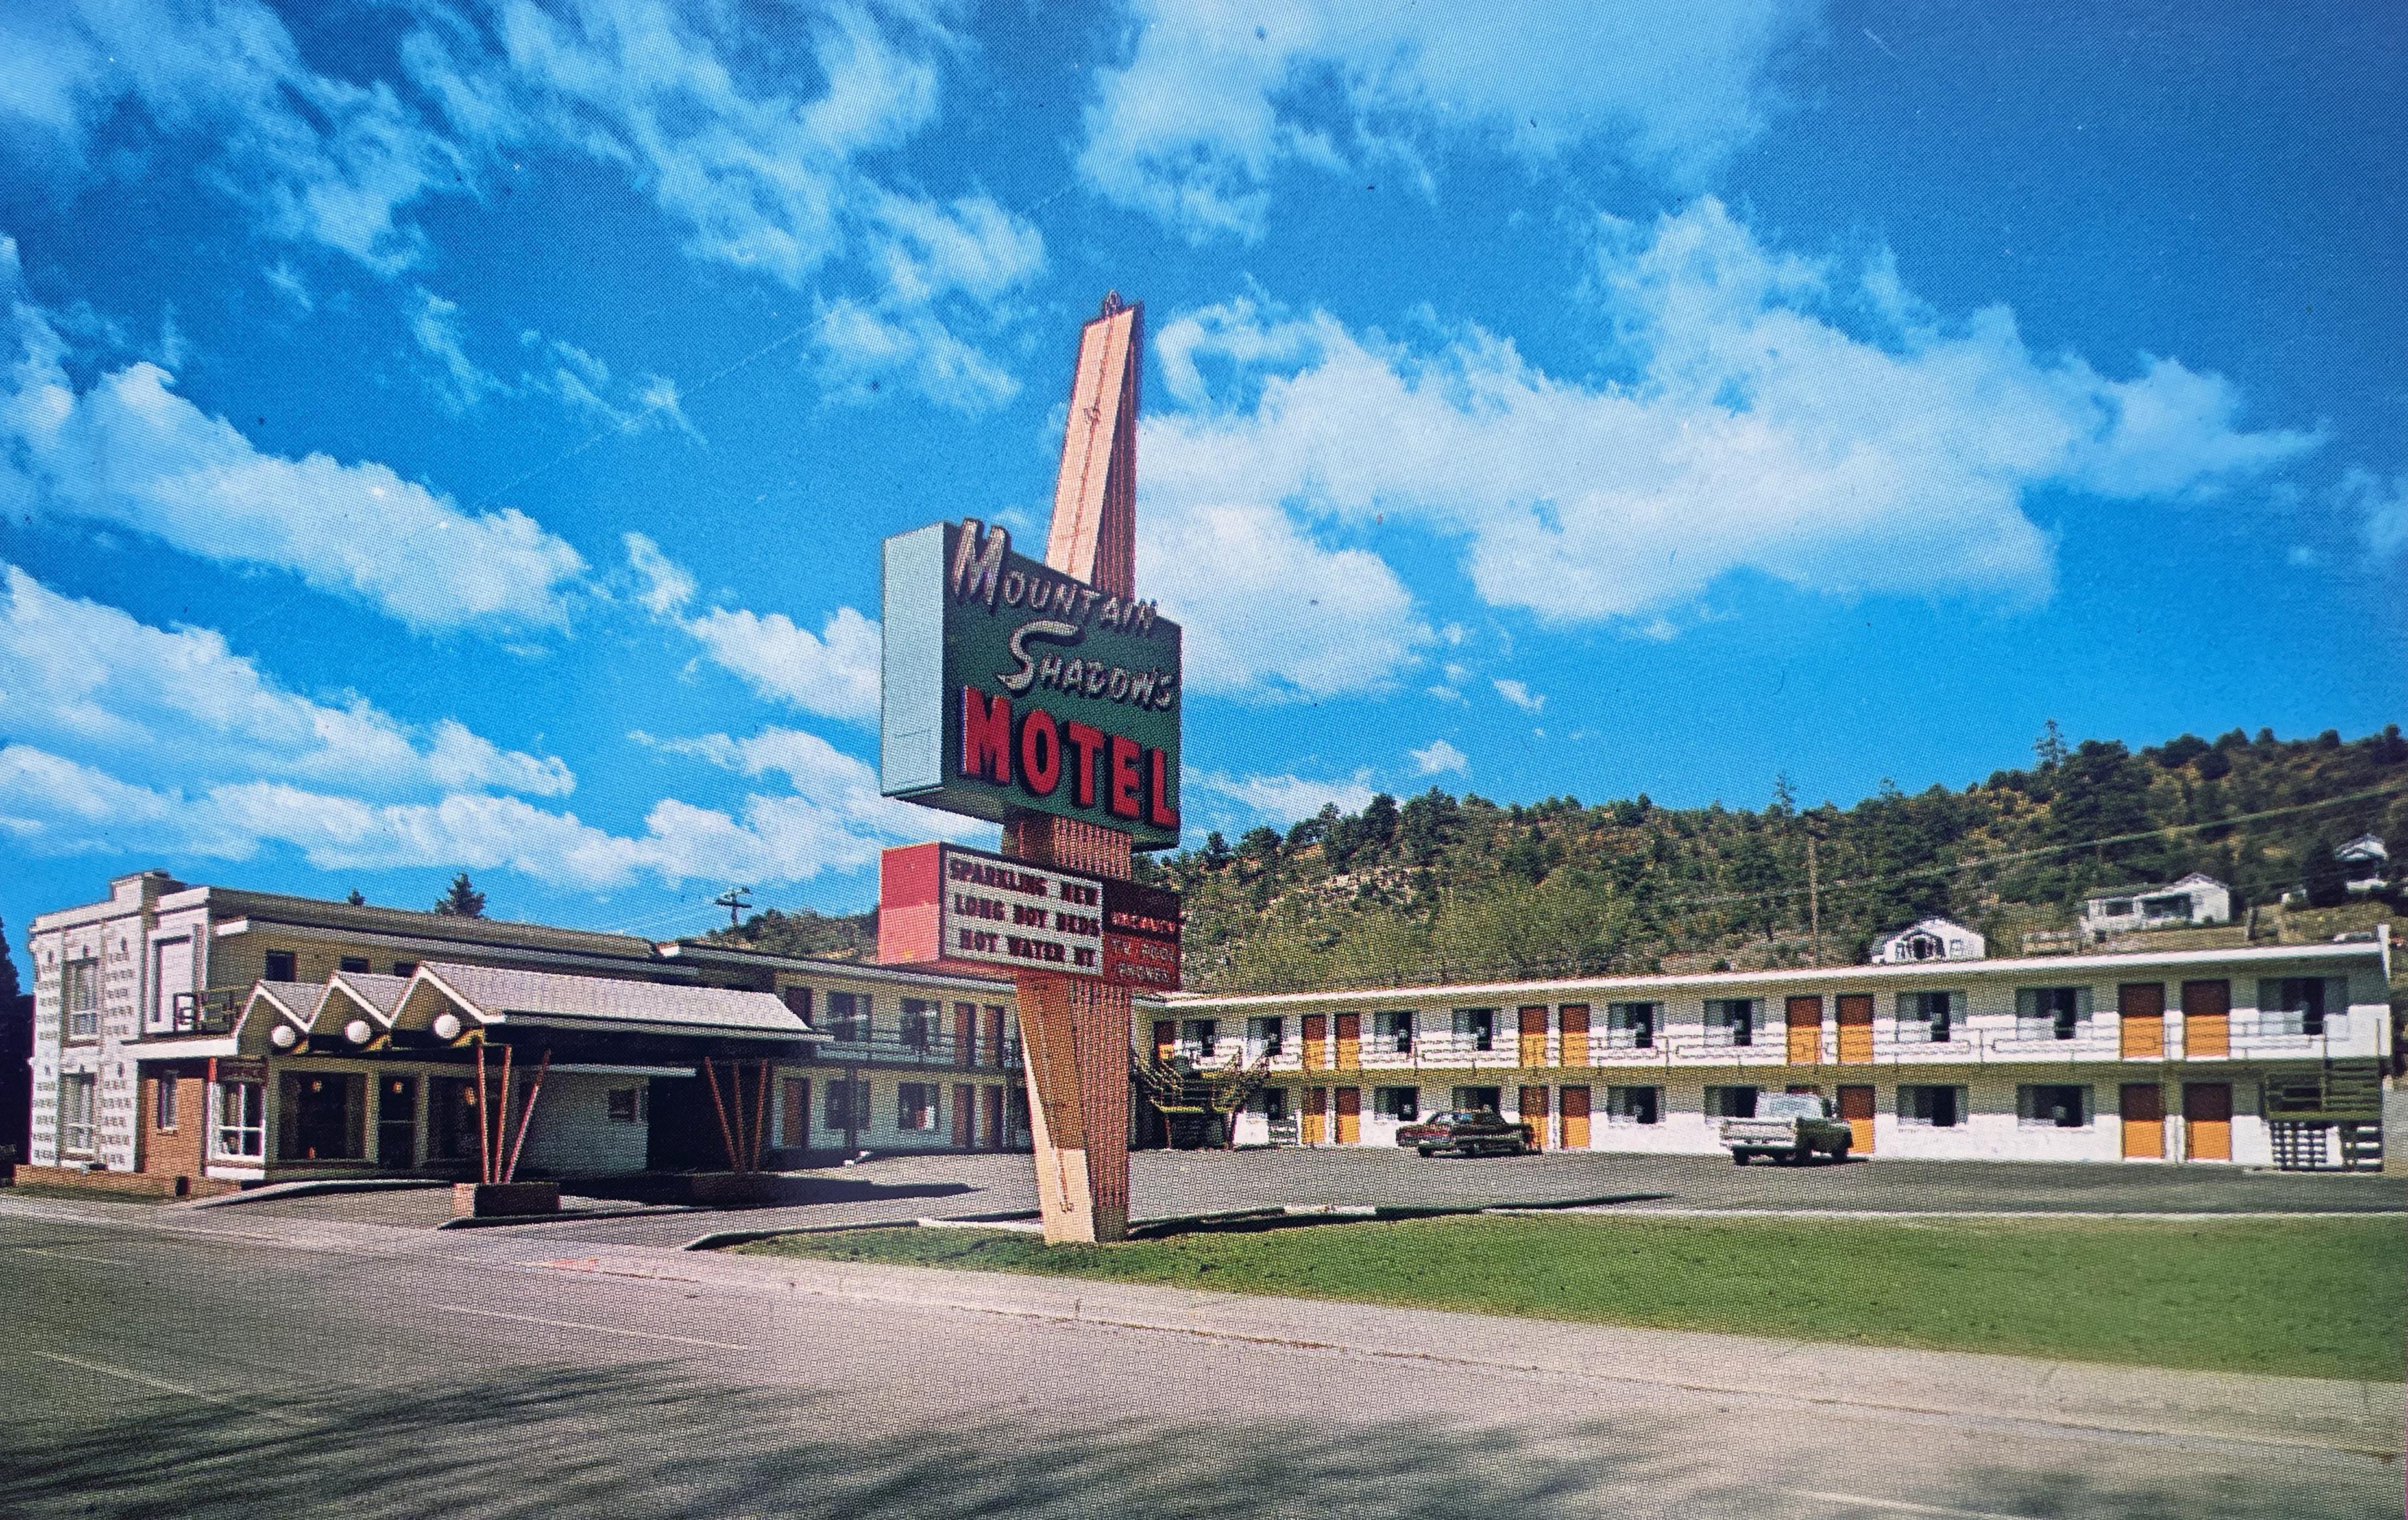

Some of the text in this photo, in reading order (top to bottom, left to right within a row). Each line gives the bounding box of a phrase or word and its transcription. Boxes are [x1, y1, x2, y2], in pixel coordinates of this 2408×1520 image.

[953, 517, 1158, 630] MOUNTAIN
[962, 684, 1178, 829] MOTEL
[950, 858, 1099, 907] SPARKLING NEW
[953, 892, 1006, 922] LONG
[1013, 905, 1049, 930] BOY
[959, 927, 999, 953] HOT
[1006, 935, 1065, 963] WATER
